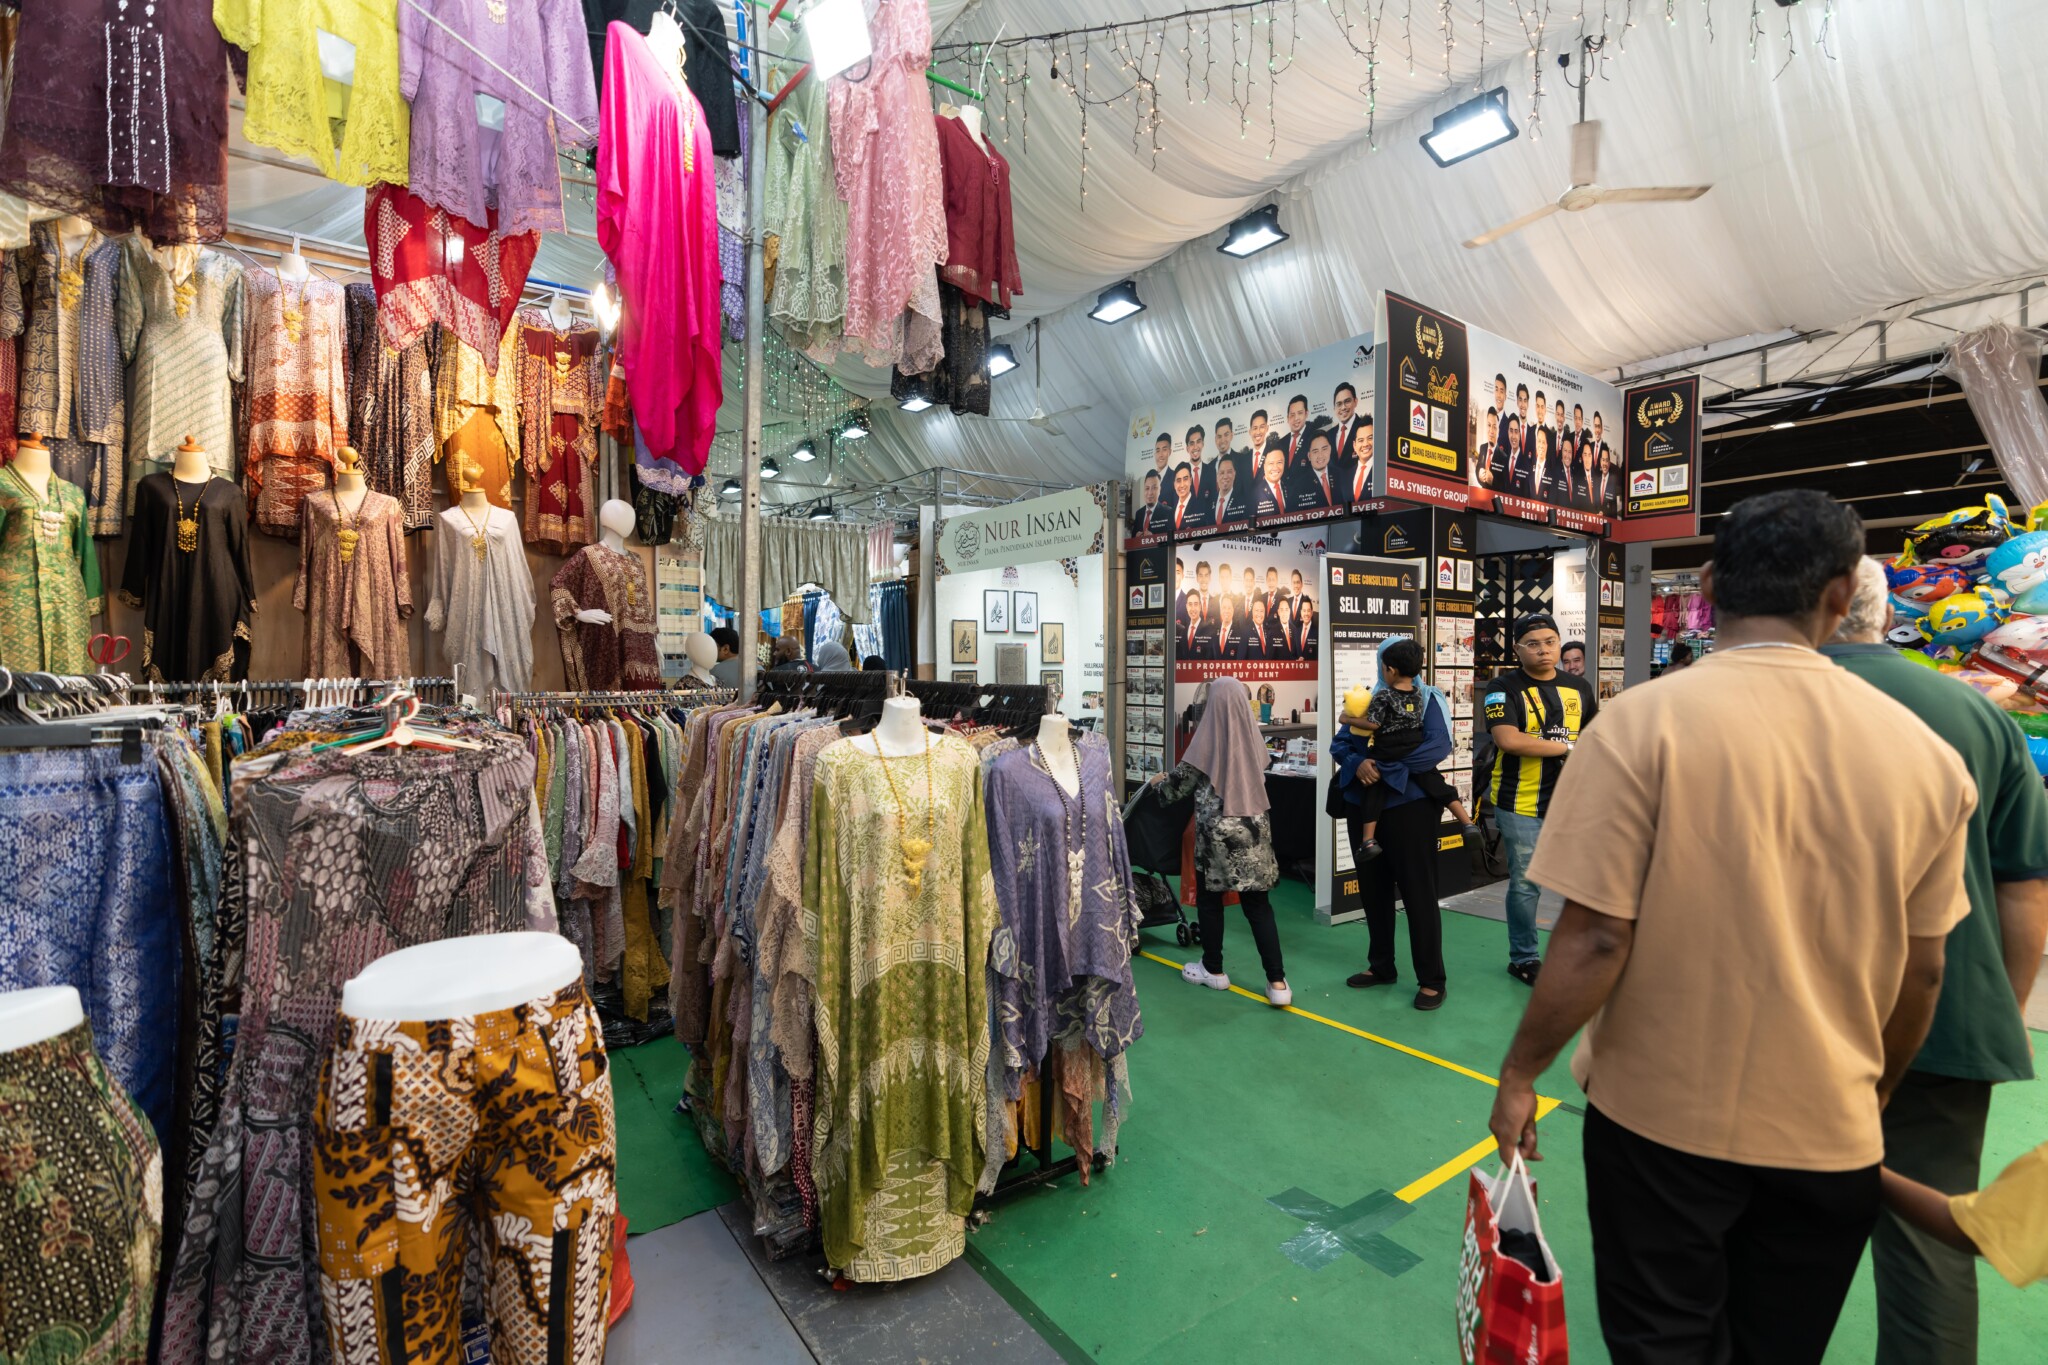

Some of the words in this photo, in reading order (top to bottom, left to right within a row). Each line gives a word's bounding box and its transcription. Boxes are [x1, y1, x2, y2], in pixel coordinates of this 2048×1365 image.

[1200, 384, 1228, 397] AWARD
[1232, 371, 1270, 386] WINNING
[1274, 360, 1304, 373] AGENT
[1518, 360, 1538, 375] ABANG
[1538, 368, 1557, 383] ABANG
[1557, 376, 1583, 393] PROPERTY
[1190, 397, 1222, 412] ABANG
[1222, 385, 1256, 402] ABANG
[1257, 368, 1311, 391] PROPERTY
[1551, 382, 1569, 394] ESTATE
[1222, 401, 1241, 409] REAL
[1245, 389, 1277, 402] ESTATE
[1649, 400, 1671, 410] AWARD
[1647, 406, 1673, 417] WINNING
[1413, 417, 1425, 428] ERA
[1412, 446, 1425, 456] ABANG
[1425, 449, 1437, 460] ABANG
[1437, 453, 1455, 465] PROPERTY
[1389, 477, 1405, 491] ERA
[1407, 481, 1442, 498] SYNERGY
[1443, 490, 1469, 503] GROUP
[985, 519, 1021, 543] NUR
[1026, 506, 1081, 536] INSAN
[1141, 537, 1155, 545] ERA
[1156, 532, 1189, 543] SYRGY
[1191, 527, 1218, 538] GROUP
[1261, 514, 1304, 527] WINNING
[1306, 510, 1325, 520] TOP
[1327, 501, 1385, 517] ACEVERS
[1566, 520, 1584, 530] RENT
[1035, 539, 1052, 548] ISLAM
[1053, 533, 1082, 545] PERCUMA
[1248, 535, 1282, 548] PROPERTY
[1240, 545, 1262, 553] ESTATE
[1348, 573, 1361, 585] FREE
[1361, 574, 1398, 587] CONSULTATION
[1440, 573, 1451, 582] ERA
[1339, 596, 1360, 614] SELL
[1367, 597, 1383, 614] BUY
[1390, 598, 1409, 616] RENT
[1435, 601, 1445, 612] FREE
[1445, 602, 1473, 613] CONSULTATION
[1334, 630, 1347, 638] HDB
[1348, 631, 1371, 639] MEDIAN
[1176, 662, 1192, 670] REE
[1196, 662, 1243, 670] PROPERTY
[1246, 662, 1310, 670] CONSULTATION
[1203, 671, 1223, 679] SELL
[1233, 671, 1249, 679] BUY
